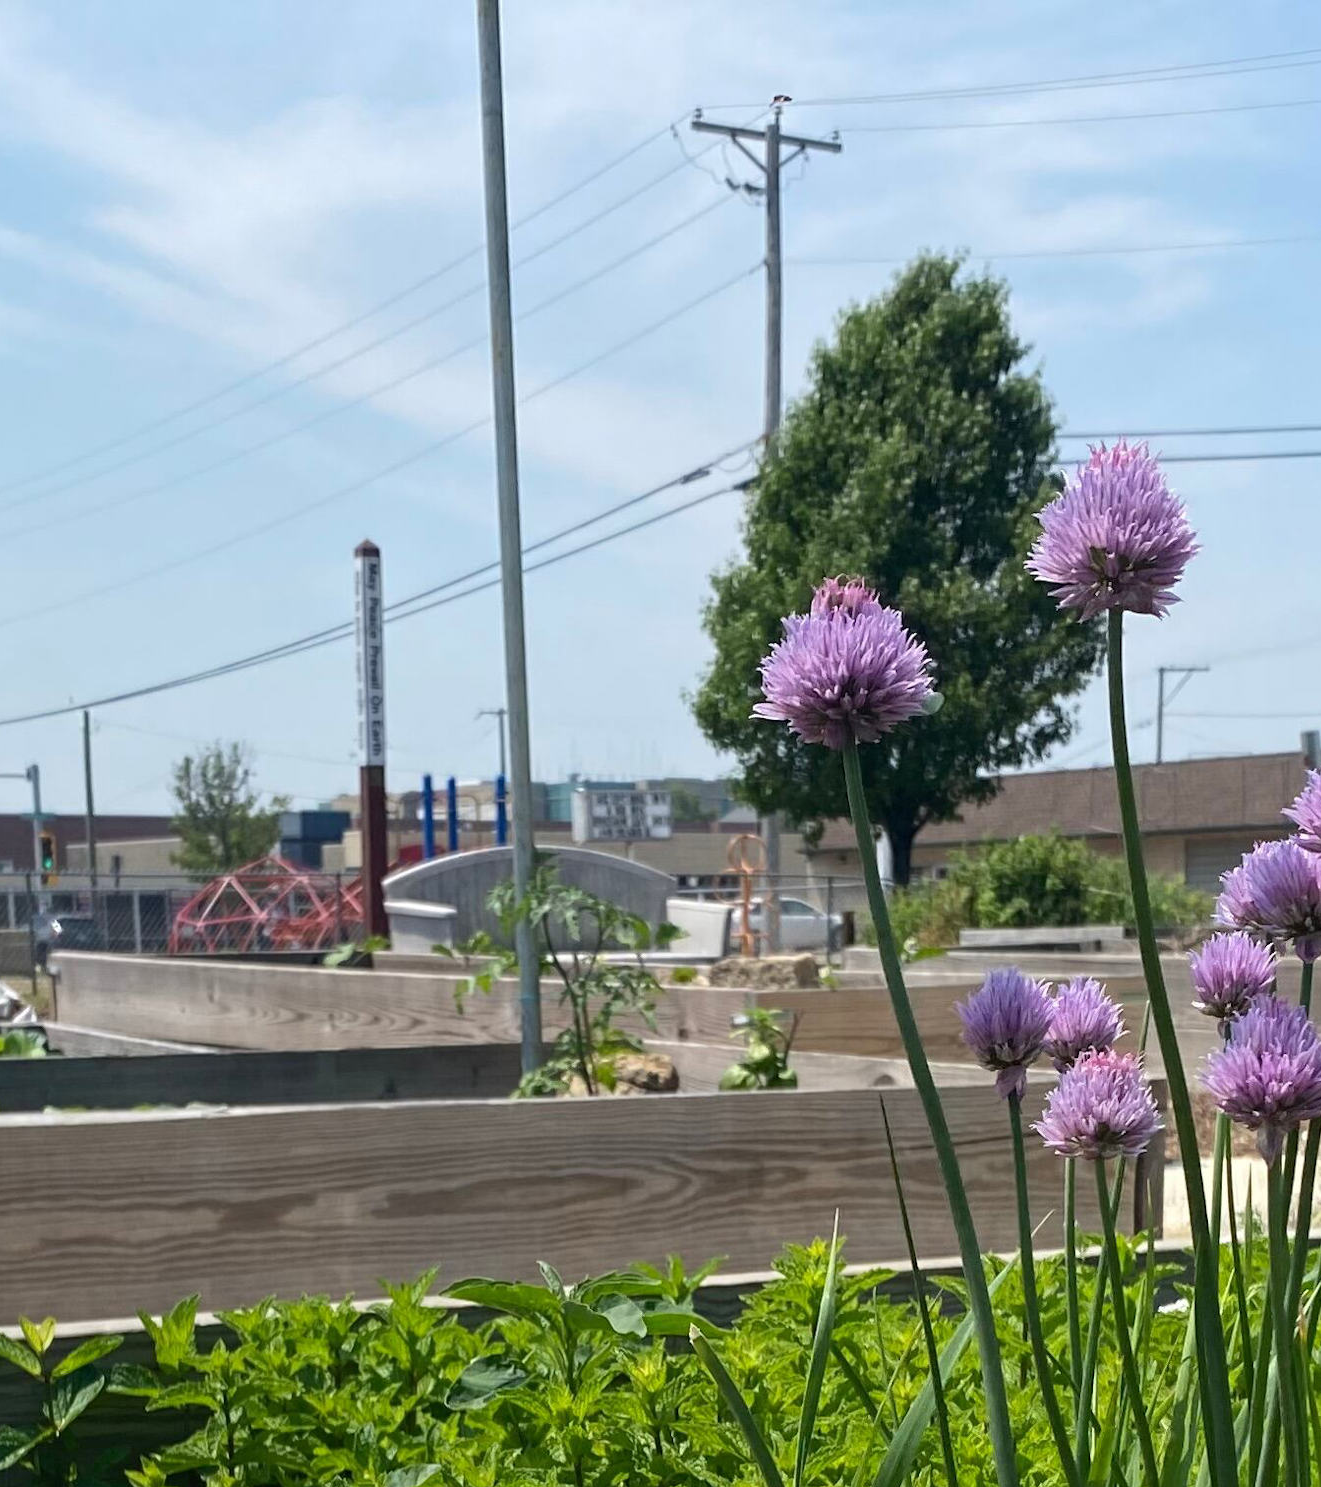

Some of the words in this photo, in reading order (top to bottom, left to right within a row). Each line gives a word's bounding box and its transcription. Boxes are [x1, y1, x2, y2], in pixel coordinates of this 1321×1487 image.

[365, 563, 378, 591] May
[369, 597, 379, 639] Peace
[369, 645, 381, 690] Prevail
[371, 695, 382, 714] On
[372, 720, 382, 756] Earth
